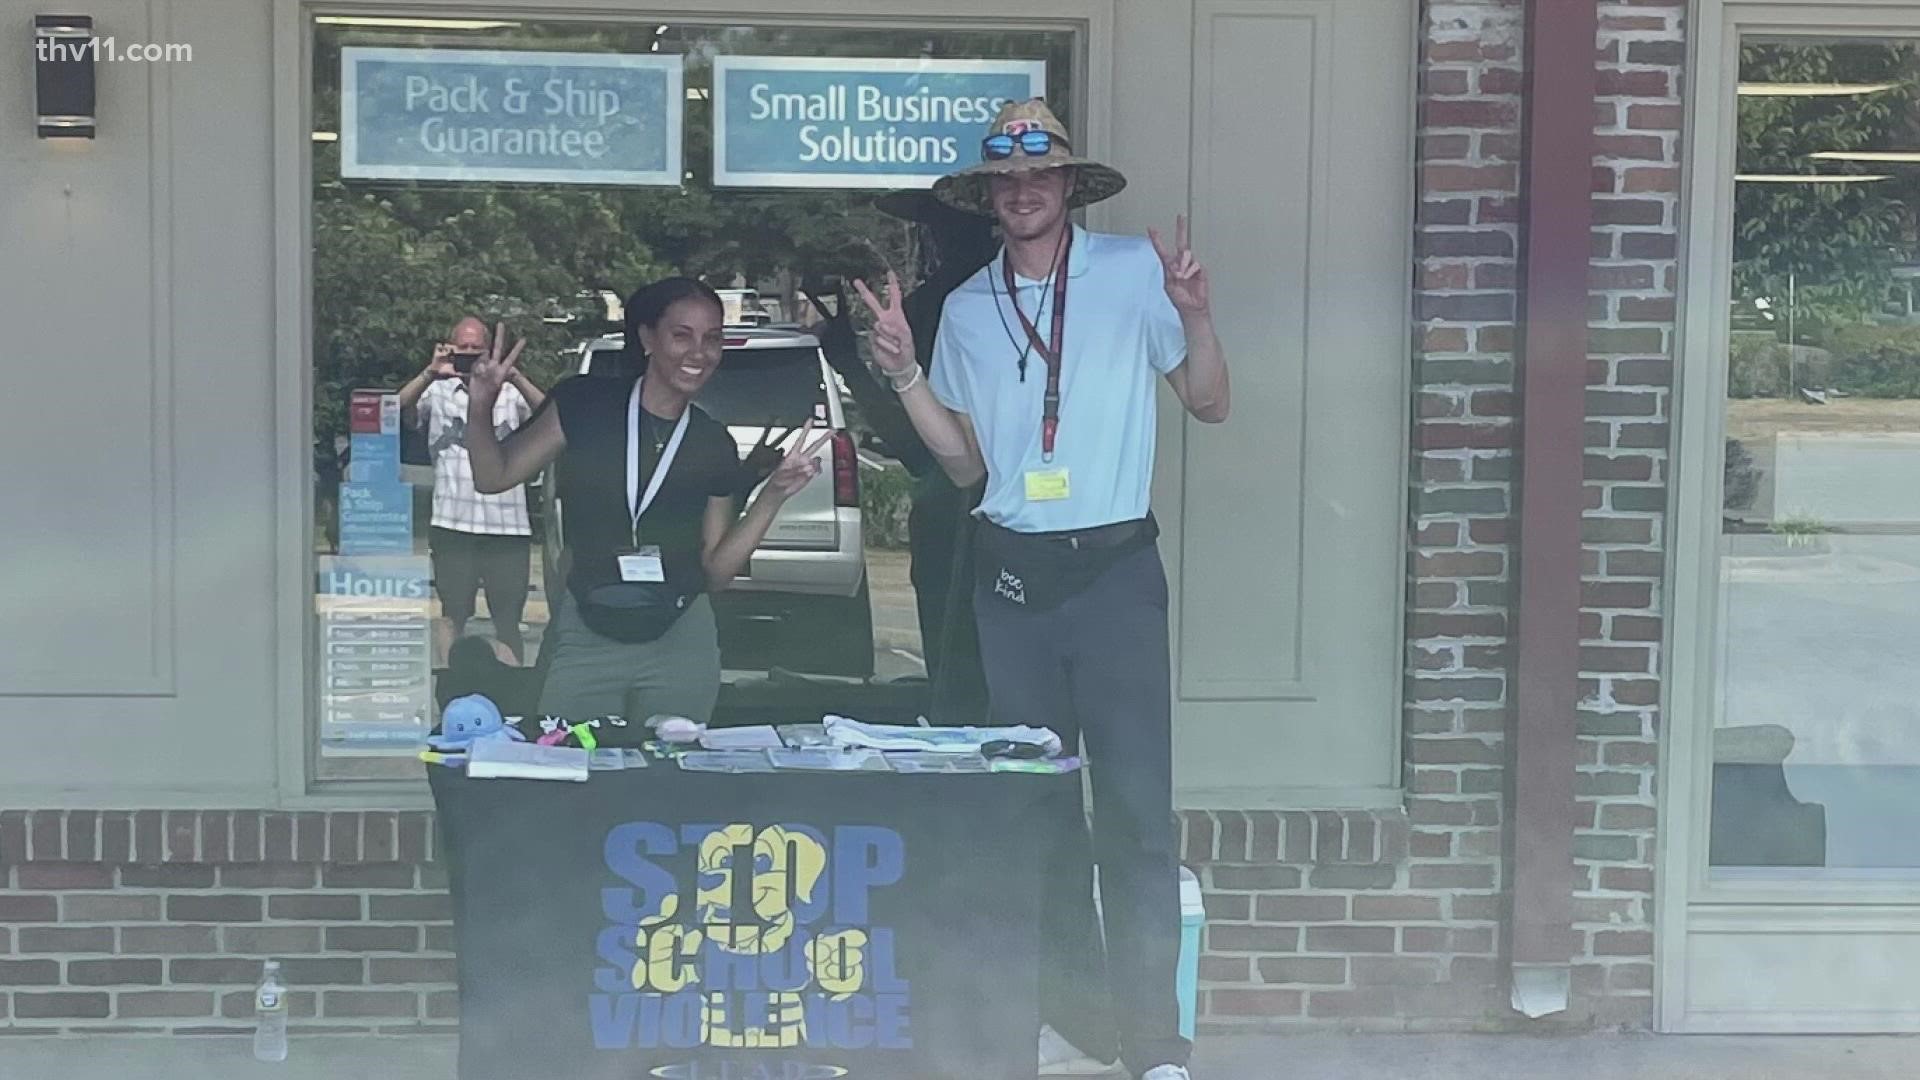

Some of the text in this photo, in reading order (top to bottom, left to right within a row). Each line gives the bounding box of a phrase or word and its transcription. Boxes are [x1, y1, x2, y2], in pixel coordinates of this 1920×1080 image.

[404, 74, 621, 125] Pack & Ship
[749, 83, 1005, 124] Small Business
[420, 116, 607, 158] Guarantee
[798, 124, 959, 164] Solutions
[328, 571, 424, 598] Hours
[600, 820, 906, 926] STOP
[593, 922, 911, 993] SCHOOL
[588, 991, 914, 1050] VIOLENCE
